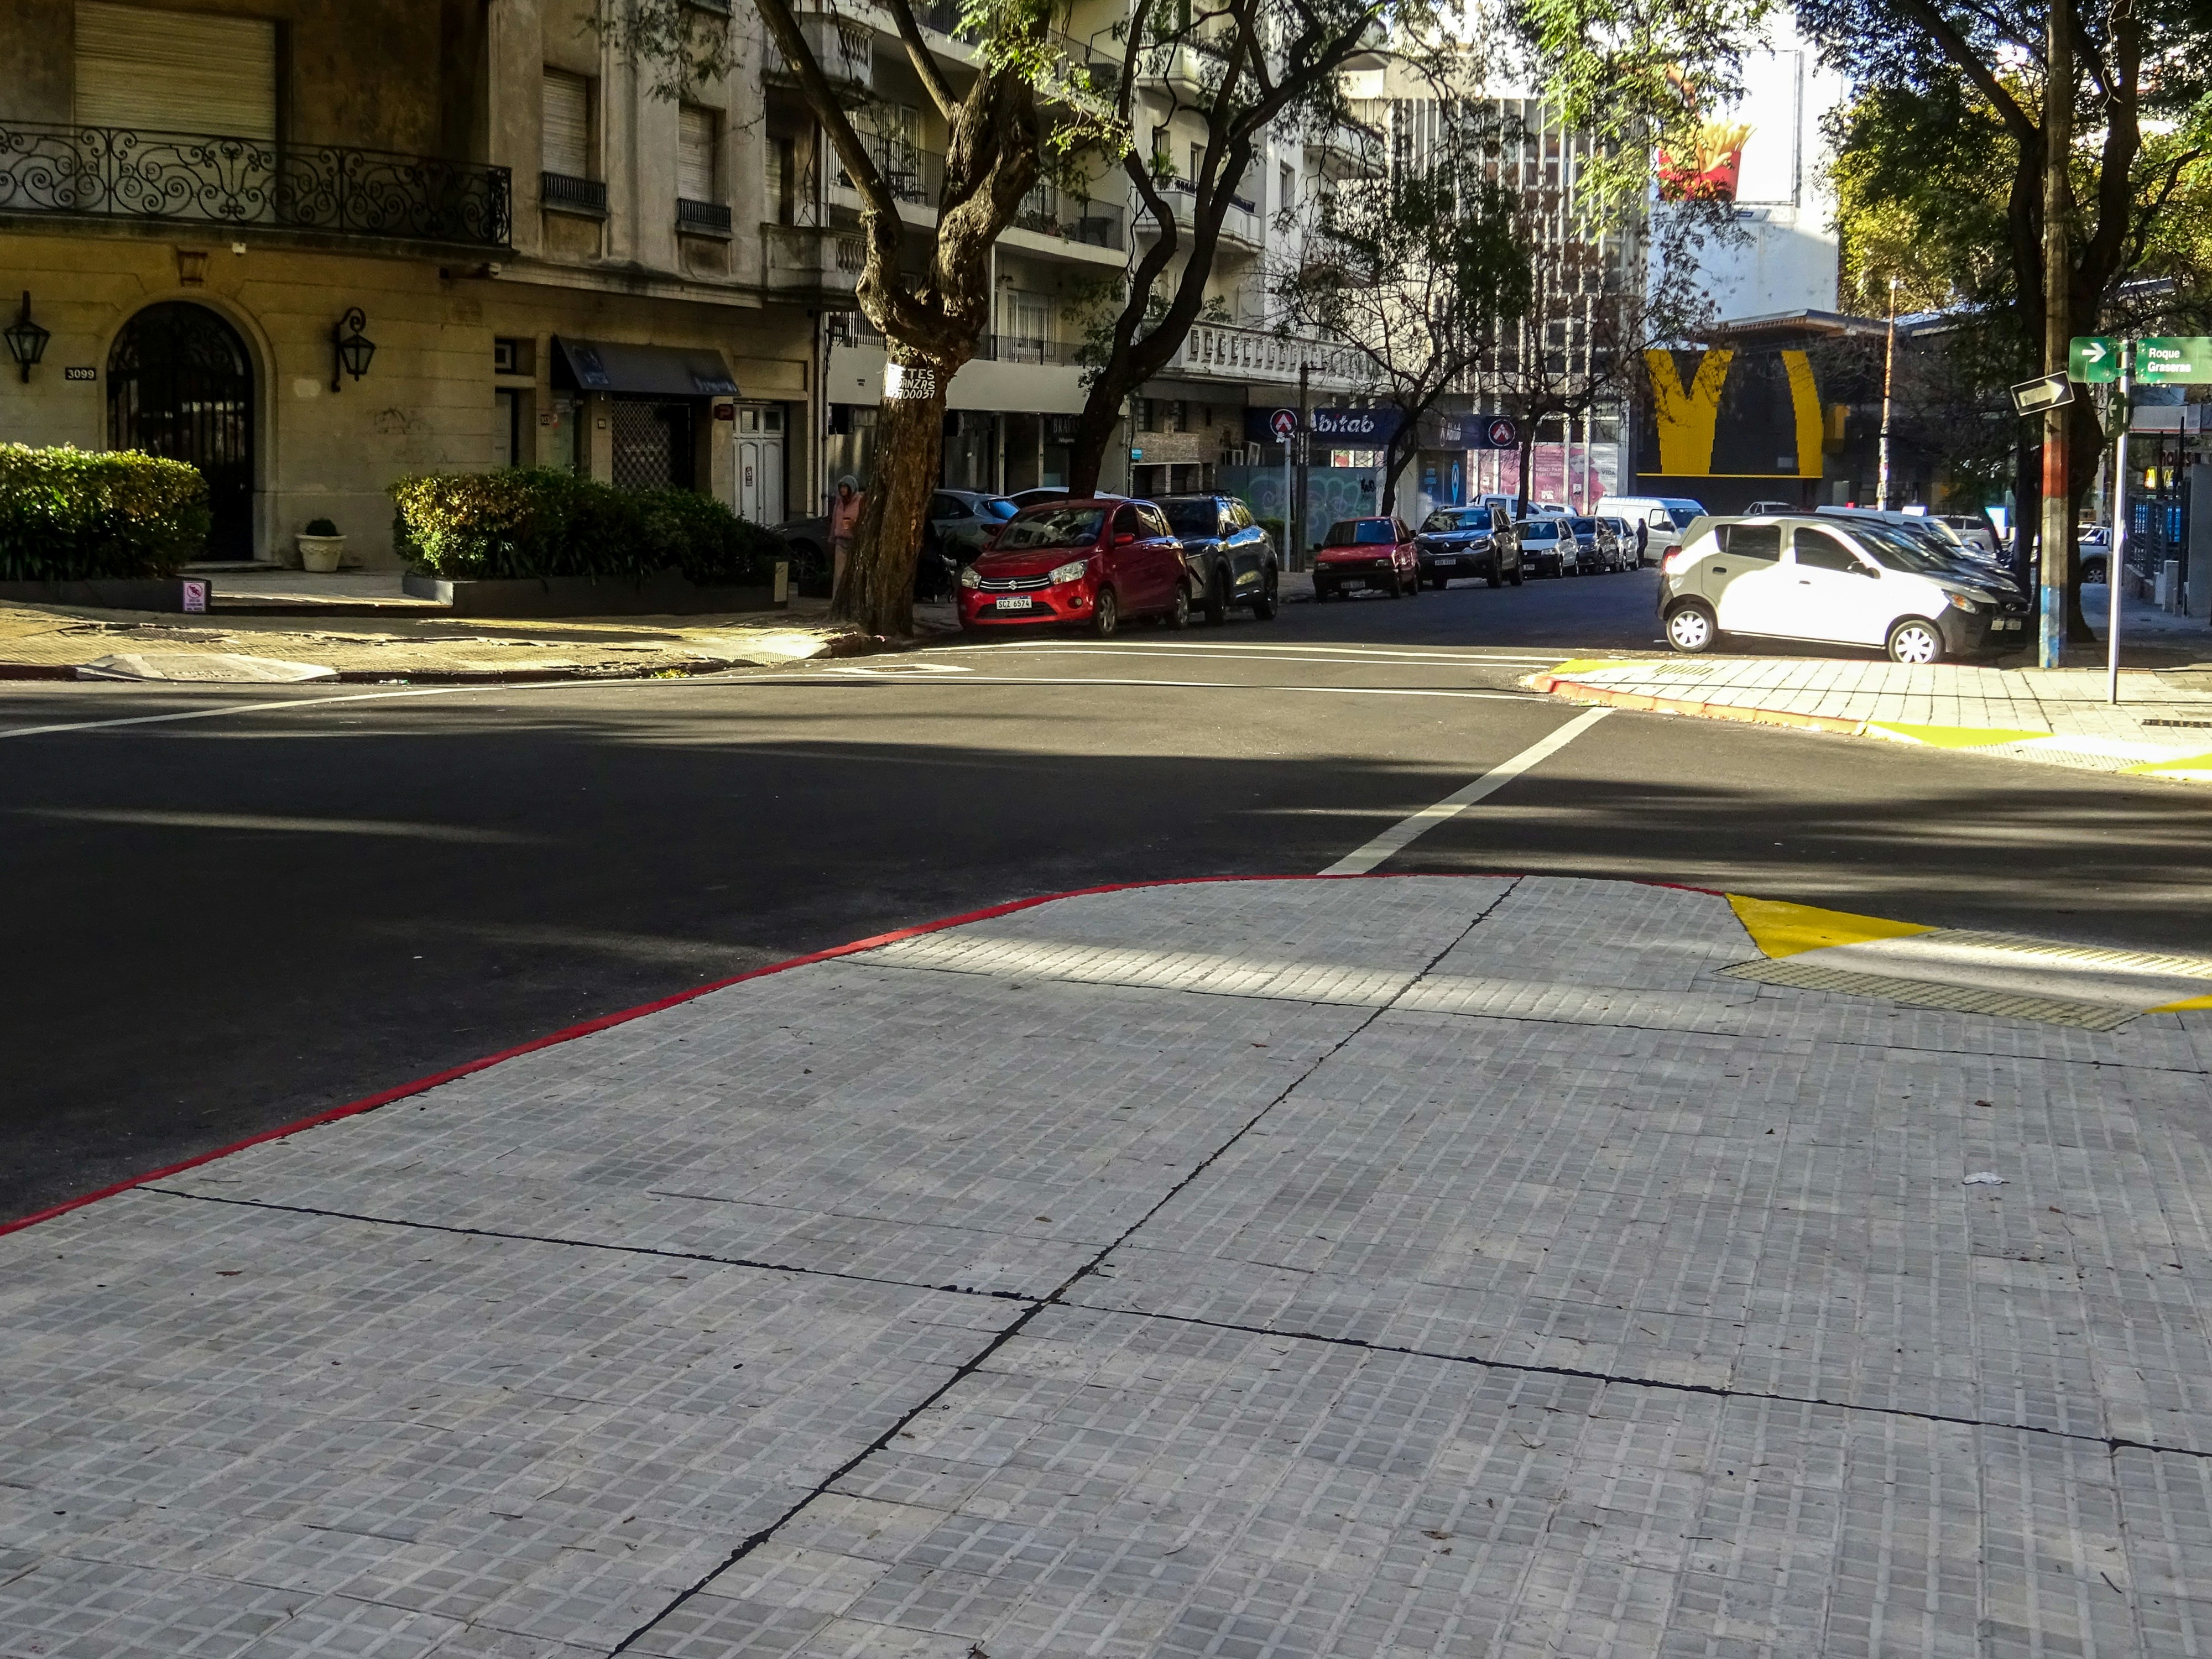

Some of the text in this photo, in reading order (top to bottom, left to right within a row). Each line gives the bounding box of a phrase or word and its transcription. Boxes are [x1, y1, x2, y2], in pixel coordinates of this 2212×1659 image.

[2149, 348, 2180, 360] Roque
[2148, 362, 2191, 372] Graseras
[67, 369, 94, 379] 3099
[887, 378, 935, 389] DANZAS
